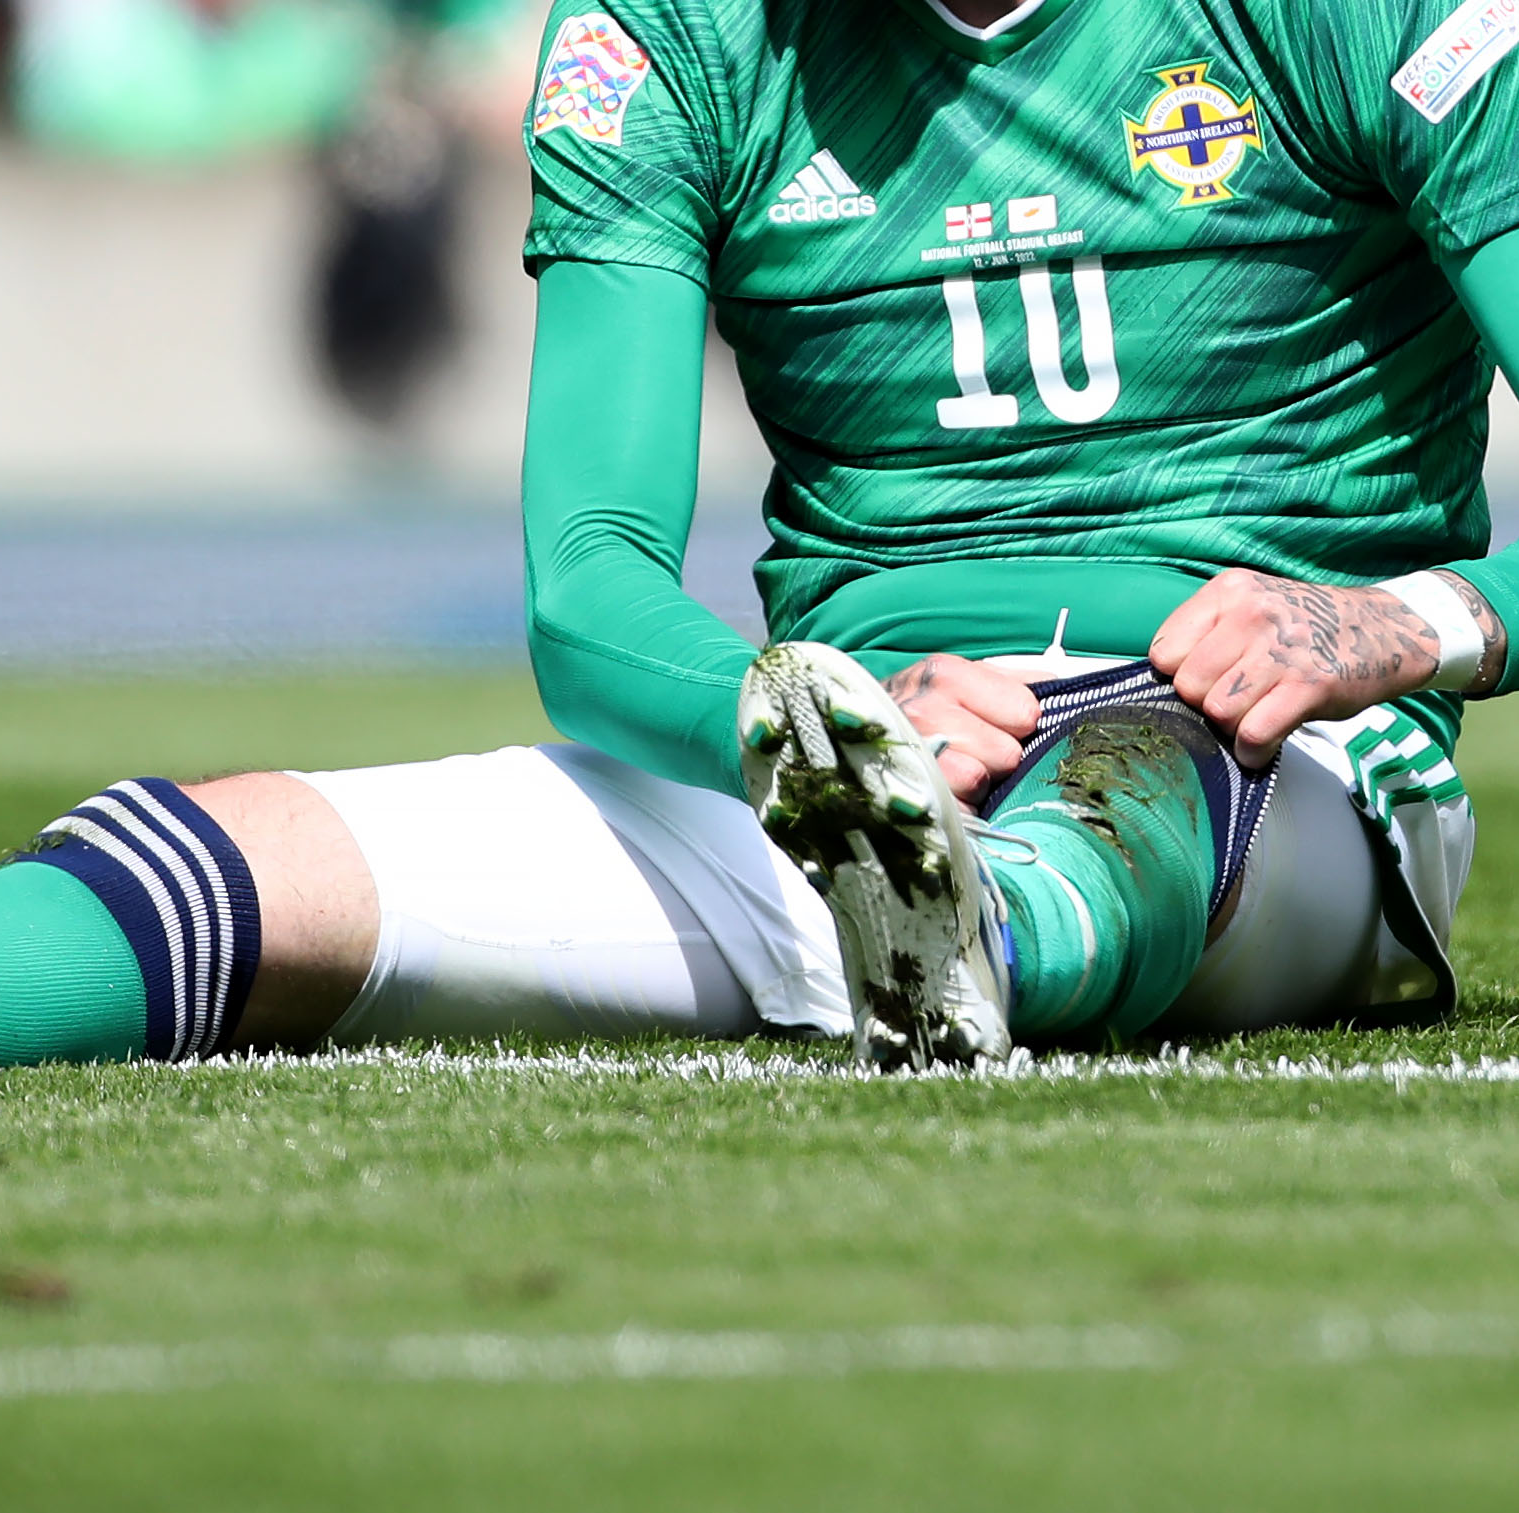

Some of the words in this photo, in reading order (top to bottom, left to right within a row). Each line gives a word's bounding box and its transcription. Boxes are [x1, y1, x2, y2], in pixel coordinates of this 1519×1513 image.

[1398, 54, 1433, 89] UEFA
[1153, 98, 1174, 126] IRISH
[1174, 89, 1230, 112] FOOTBALL
[1146, 129, 1199, 149] NORTHERN
[1200, 121, 1243, 139] IRELAND
[1164, 149, 1235, 182] ASSOCIATION
[768, 194, 877, 224] adidas
[920, 248, 963, 262] NATIONAL
[963, 240, 1005, 257] FOOTBALL
[1006, 235, 1048, 252] STADIUM,
[1047, 229, 1085, 248] BELFAST
[990, 254, 1009, 266] JUN
[1015, 252, 1037, 265] 2022
[935, 254, 1122, 430] 10
